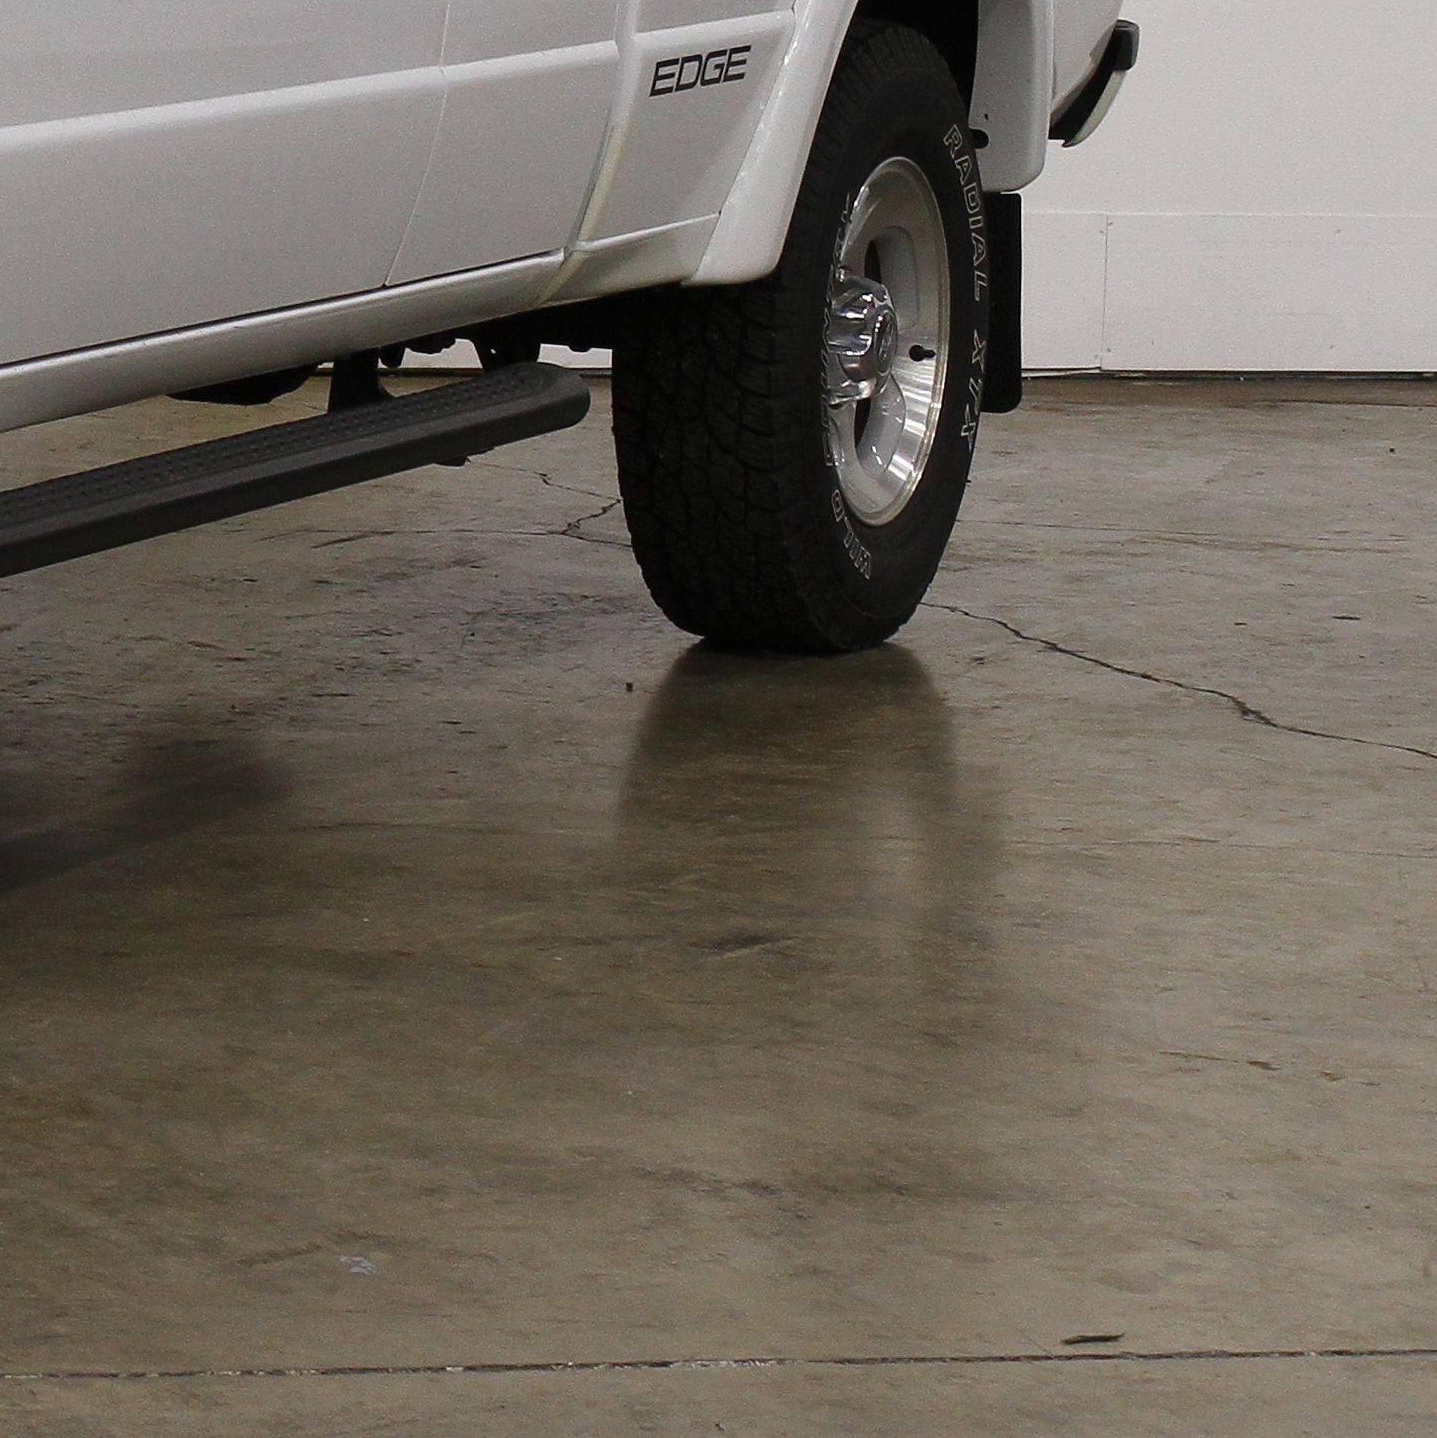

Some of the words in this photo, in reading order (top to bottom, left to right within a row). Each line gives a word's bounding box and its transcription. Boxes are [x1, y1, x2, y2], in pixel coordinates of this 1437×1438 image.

[649, 45, 752, 97] EDGE
[943, 124, 987, 302] RADIAL
[831, 489, 871, 580] WILD
